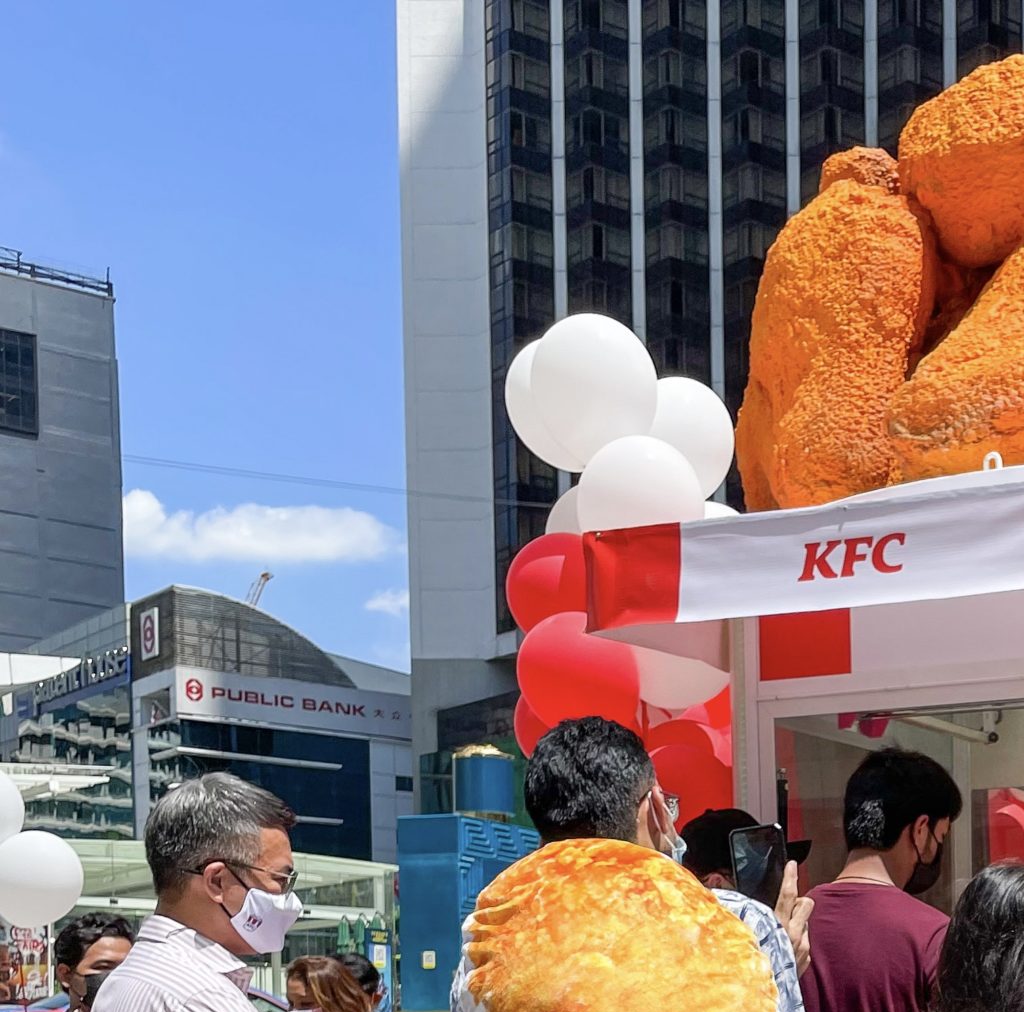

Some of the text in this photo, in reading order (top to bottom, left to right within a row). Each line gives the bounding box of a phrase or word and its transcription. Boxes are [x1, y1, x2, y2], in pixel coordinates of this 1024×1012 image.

[797, 532, 906, 582] KFC
[211, 686, 367, 718] PUBLIC BANK
